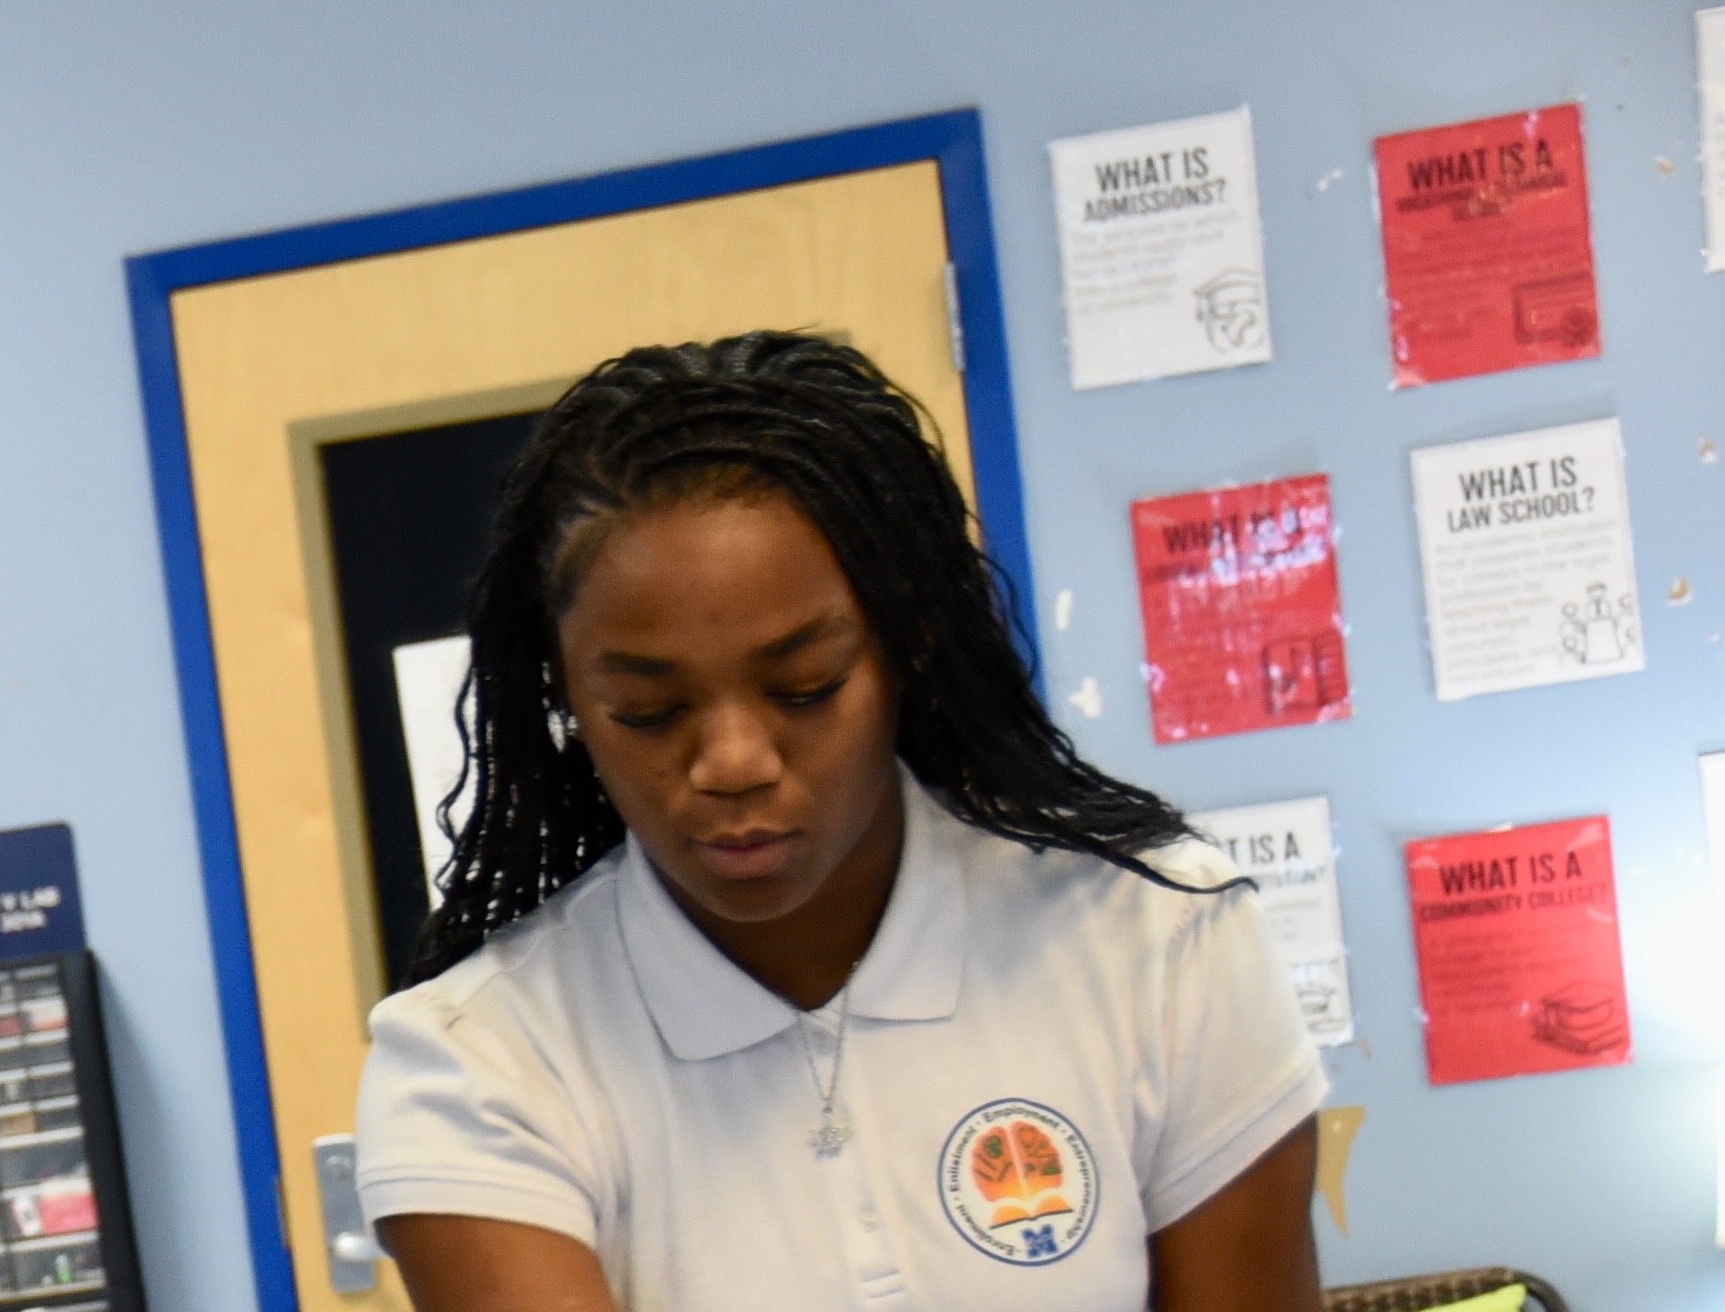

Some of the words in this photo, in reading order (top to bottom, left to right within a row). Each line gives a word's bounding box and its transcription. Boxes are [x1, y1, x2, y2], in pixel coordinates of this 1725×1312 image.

[1095, 153, 1172, 192] WHAT
[1183, 147, 1209, 179] IS
[1407, 148, 1486, 191] WHAT
[1499, 142, 1524, 175] IS
[1535, 139, 1553, 169] A
[1084, 178, 1226, 222] ADMISSIONS?
[1458, 461, 1540, 502] WHAT
[1551, 456, 1577, 488] IS
[1447, 504, 1492, 534] LAW
[1499, 486, 1595, 525] SCHOOL?
[1249, 833, 1275, 865] IS
[1284, 832, 1300, 860] A
[1439, 856, 1518, 896] WHAT
[1530, 853, 1556, 883] IS
[1565, 850, 1583, 879] A
